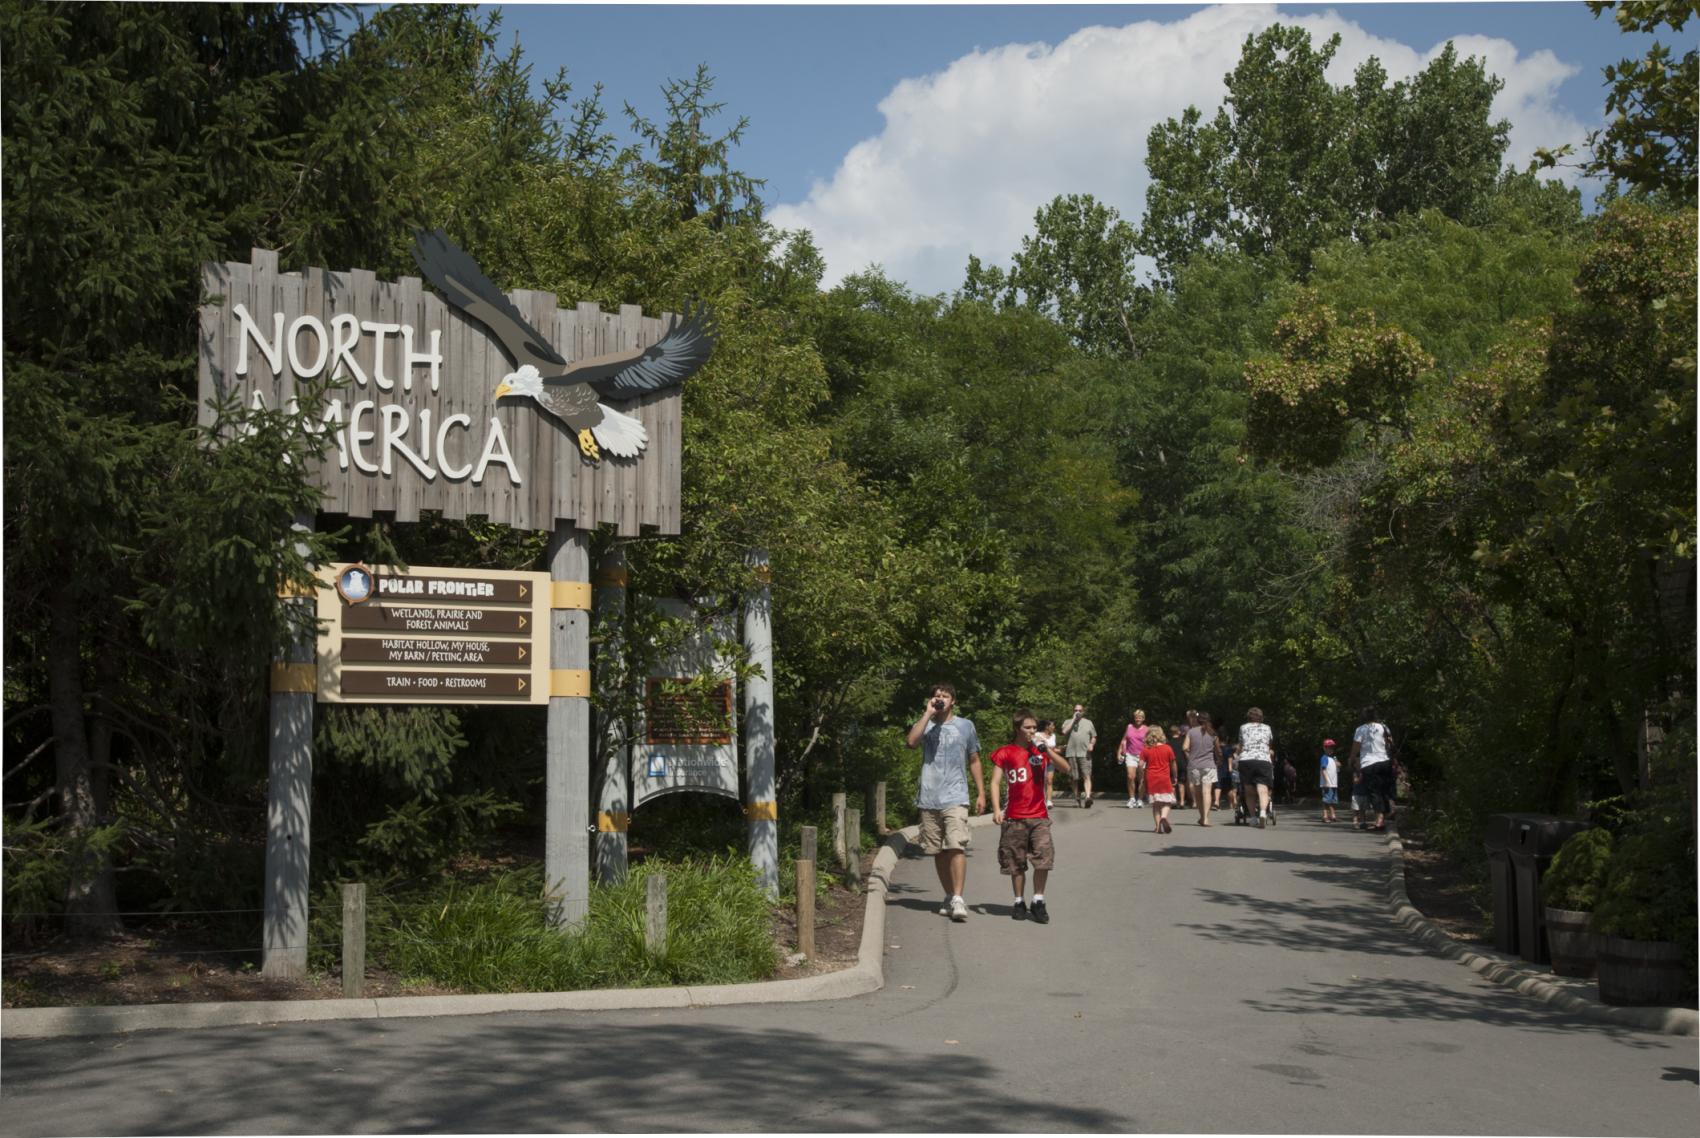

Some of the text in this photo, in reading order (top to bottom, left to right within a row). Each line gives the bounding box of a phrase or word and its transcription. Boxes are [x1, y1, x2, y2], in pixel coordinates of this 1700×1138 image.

[233, 303, 443, 391] NORTH
[379, 578, 424, 594] POLAR
[391, 608, 483, 620] WETLANDS, PRAIRIE AND
[406, 620, 469, 631] FOREST ANIMALS
[382, 639, 414, 649] HABITAT
[416, 640, 450, 651] HOLLOW,
[465, 642, 490, 652] HOUSE,
[404, 651, 425, 661] BARN
[431, 652, 462, 662] PETTING
[463, 653, 484, 662] AREA
[386, 676, 487, 688] TRAIN FOOD RESTROOMS
[1008, 767, 1027, 784] 33
